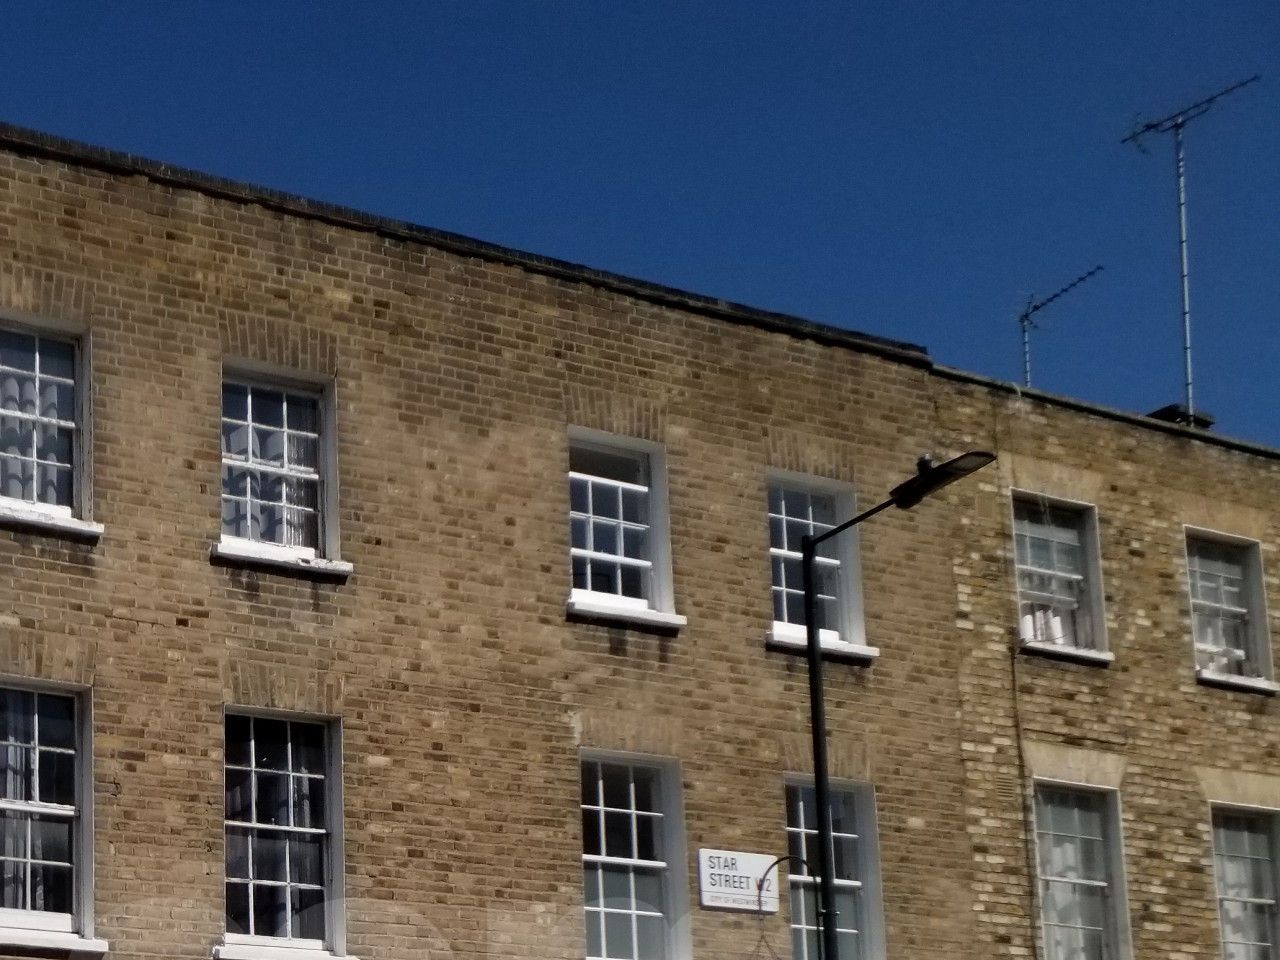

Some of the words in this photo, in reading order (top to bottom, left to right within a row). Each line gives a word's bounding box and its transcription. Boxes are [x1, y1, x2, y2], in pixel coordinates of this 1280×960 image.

[708, 855, 738, 871] STAR
[709, 873, 751, 890] STREET
[732, 898, 768, 907] WESTMINSER
